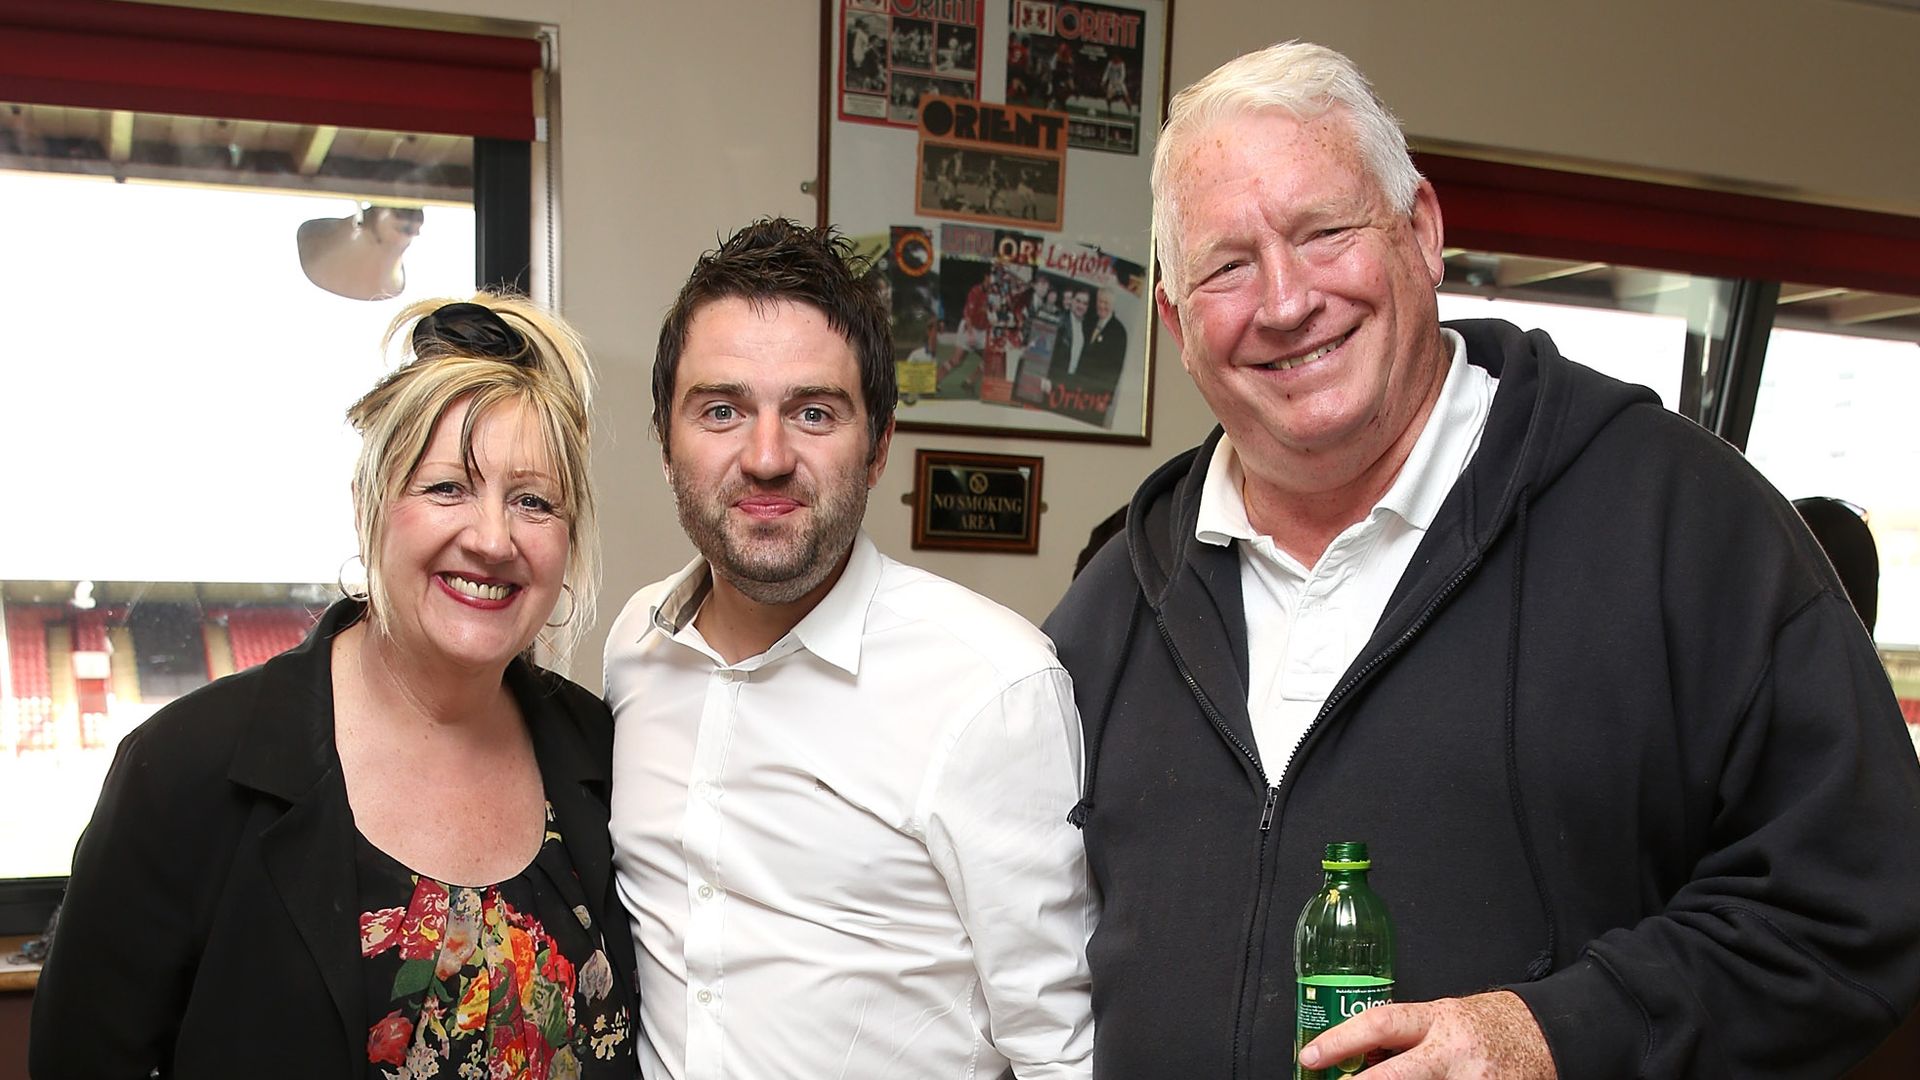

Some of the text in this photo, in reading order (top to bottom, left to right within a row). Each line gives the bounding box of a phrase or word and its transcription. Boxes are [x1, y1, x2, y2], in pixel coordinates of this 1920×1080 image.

[1056, 6, 1141, 49] ORIENT
[922, 100, 1066, 151] ORIENT
[1045, 243, 1116, 278] Leyton
[1049, 383, 1111, 413] Orient
[934, 493, 1022, 514] NO SMOKING
[960, 513, 996, 531] AREA
